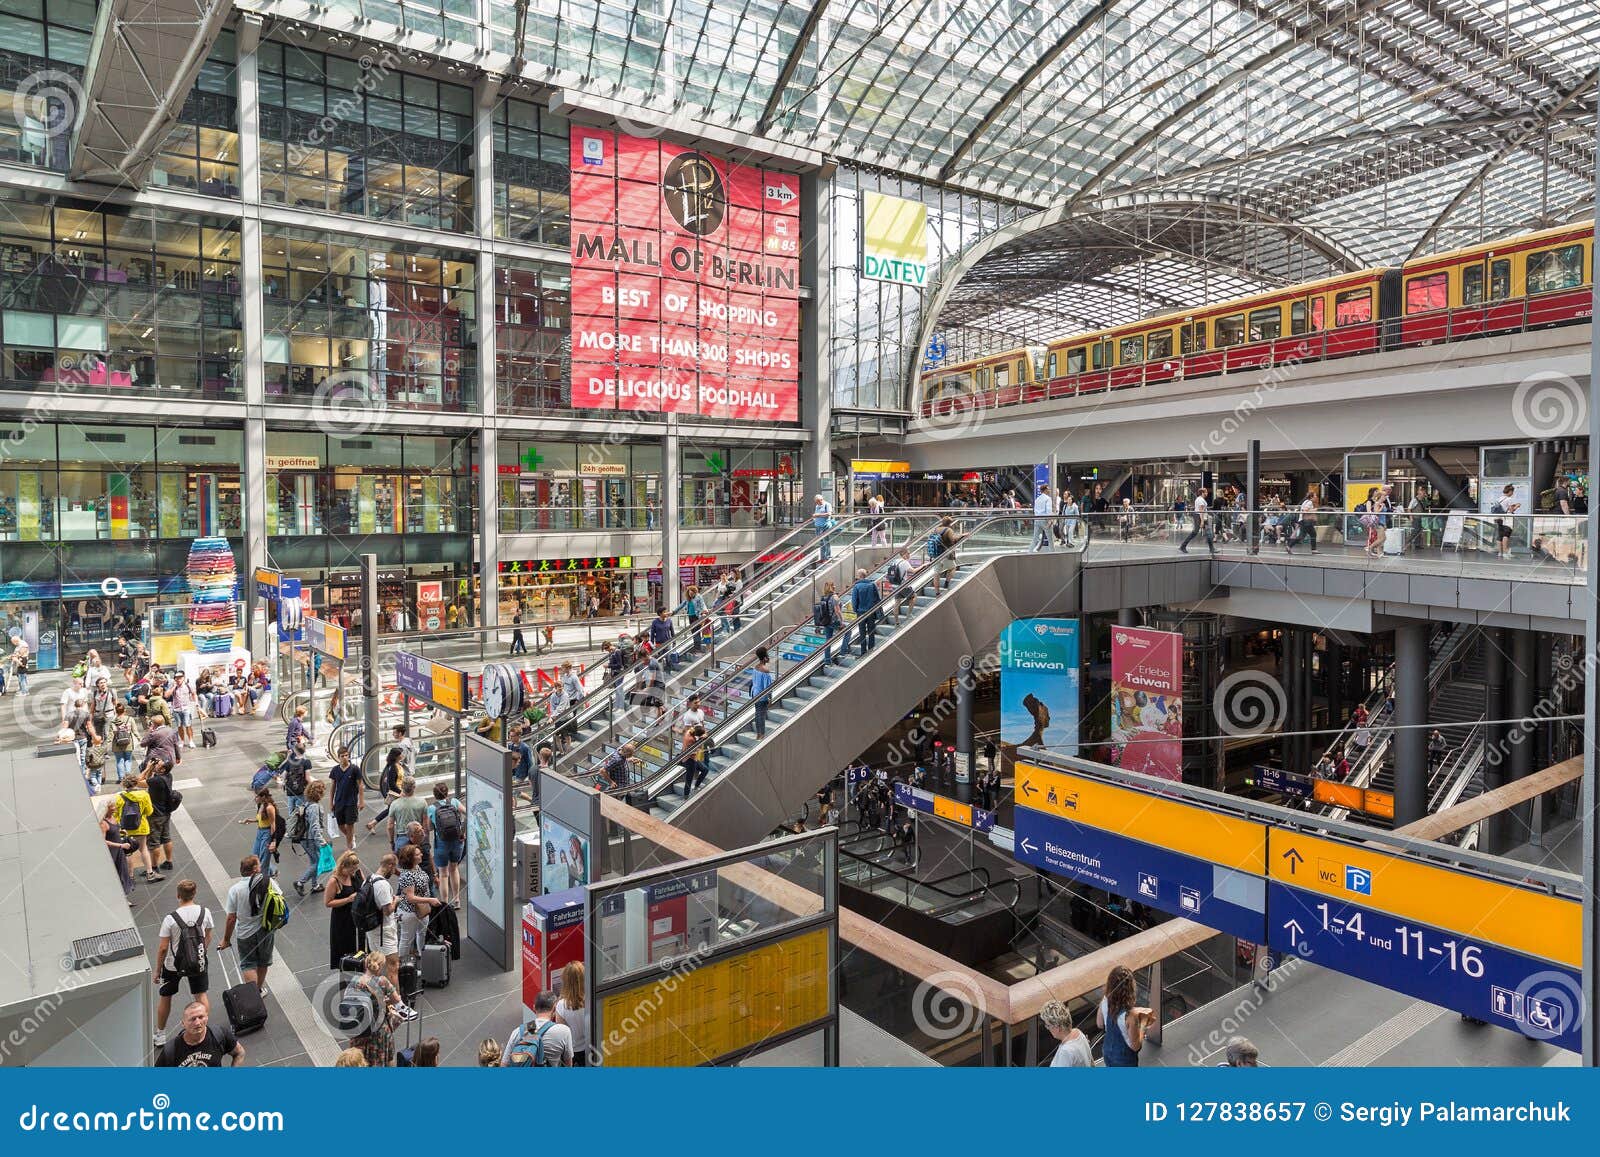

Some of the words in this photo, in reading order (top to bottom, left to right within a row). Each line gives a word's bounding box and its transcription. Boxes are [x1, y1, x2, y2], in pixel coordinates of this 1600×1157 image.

[768, 187, 775, 197] 3
[777, 189, 793, 200] km
[781, 241, 796, 251] 85
[575, 233, 660, 267] MALL
[670, 246, 704, 274] OF
[712, 254, 795, 291] BERLIN
[865, 255, 926, 284] DATEV
[602, 286, 651, 308] BEST
[664, 293, 689, 313] OF
[700, 300, 778, 328] SHOPPING
[579, 331, 642, 352] MORE
[650, 336, 697, 358] THAN
[702, 344, 728, 362] 300
[735, 350, 791, 370] SHOPS
[588, 377, 693, 401] DELICIOUS
[699, 385, 779, 410] FOODHALL
[278, 458, 317, 467] geöffnet
[598, 464, 624, 474] geöffnet
[341, 572, 396, 582] ETNA
[1014, 650, 1048, 659] Erlebe
[1014, 658, 1064, 670] Taiwan
[1138, 665, 1170, 678] Erlebe
[1125, 672, 1170, 689] Taiwan
[850, 769, 856, 780] 5
[860, 767, 867, 777] 6
[1263, 769, 1280, 779] 11-16
[1045, 841, 1101, 868] Reisezentrum
[530, 861, 539, 893] Abfall
[1319, 870, 1337, 883] WC
[1353, 873, 1366, 890] P
[553, 909, 585, 921] Fahrkarte
[1331, 925, 1343, 935] Tief
[1317, 902, 1366, 941] 1-4
[1369, 936, 1392, 951] und
[1395, 926, 1485, 978] 11-16
